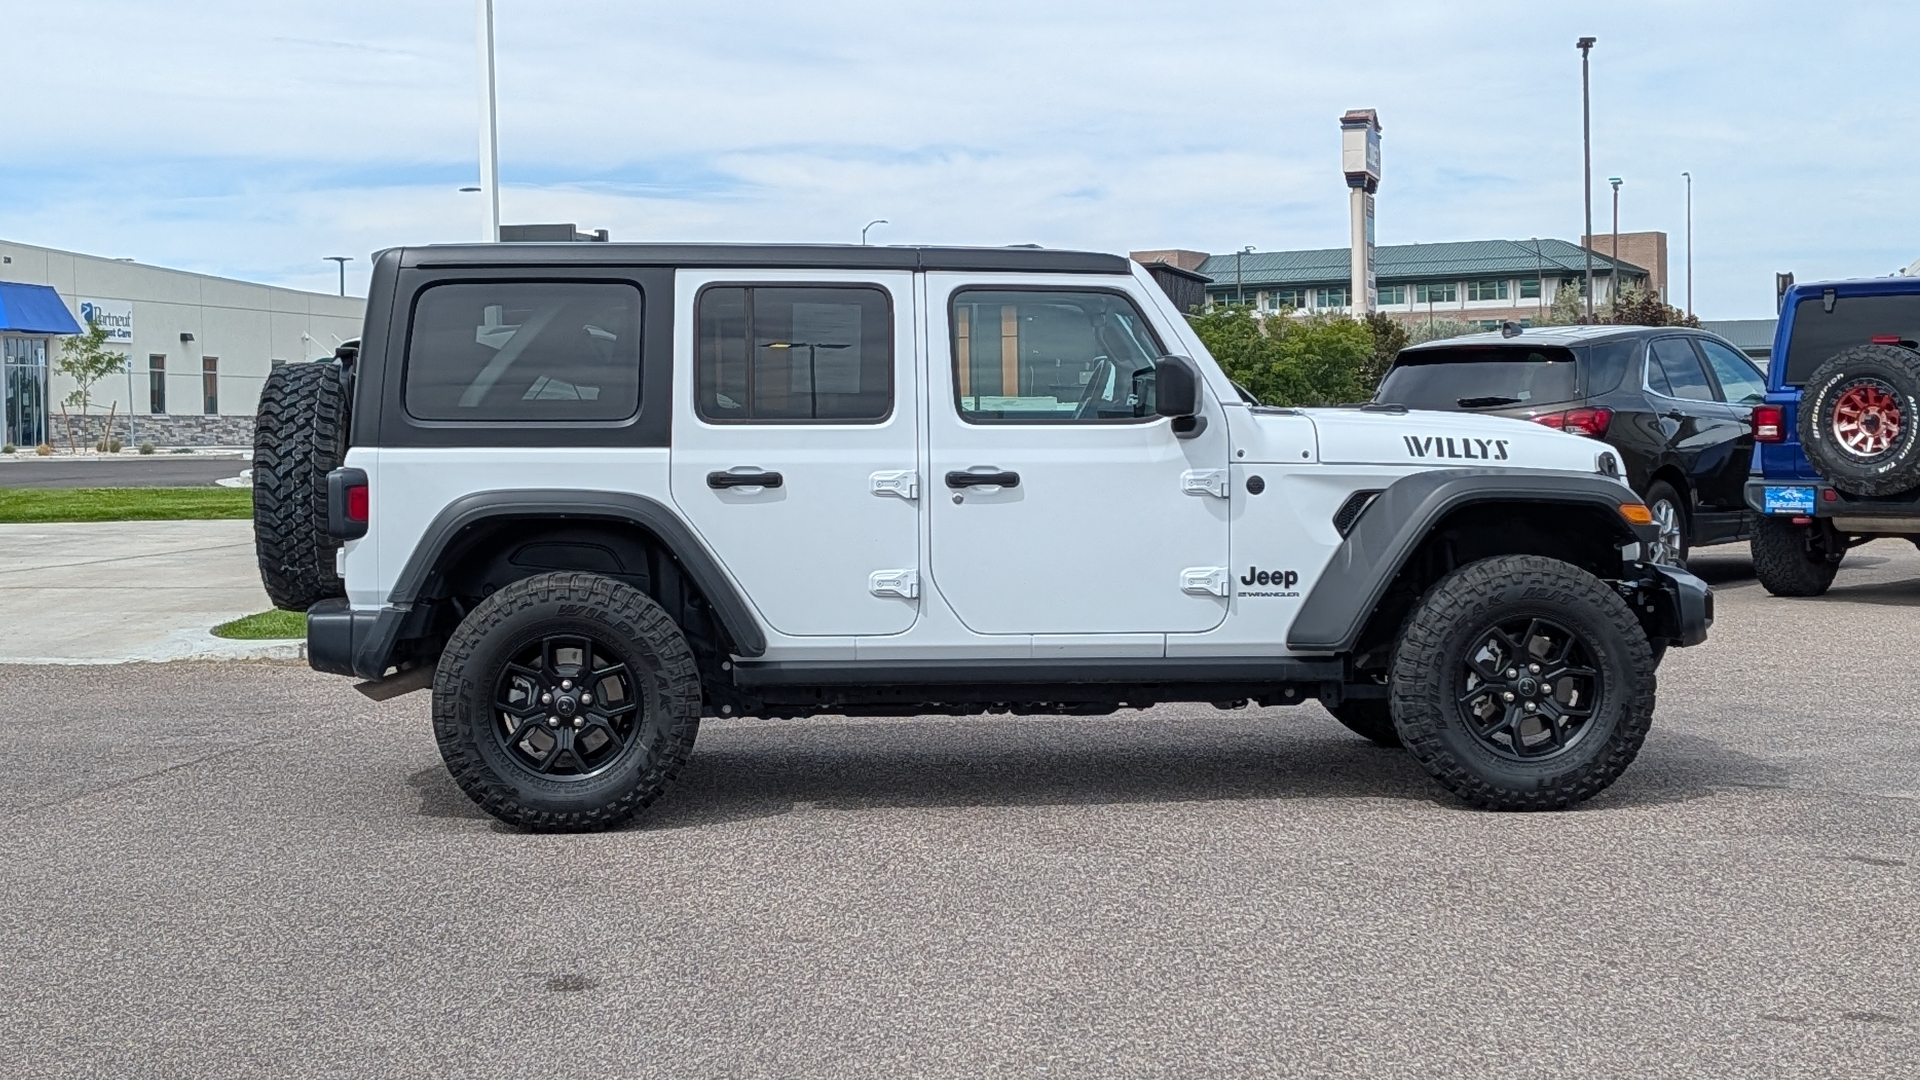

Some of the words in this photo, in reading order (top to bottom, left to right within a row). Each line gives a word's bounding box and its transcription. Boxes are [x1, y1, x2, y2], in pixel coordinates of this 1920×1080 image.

[94, 306, 131, 327] Portneuf
[117, 328, 132, 338] Care
[1402, 435, 1509, 460] WILLYS
[1240, 566, 1299, 589] Jeep
